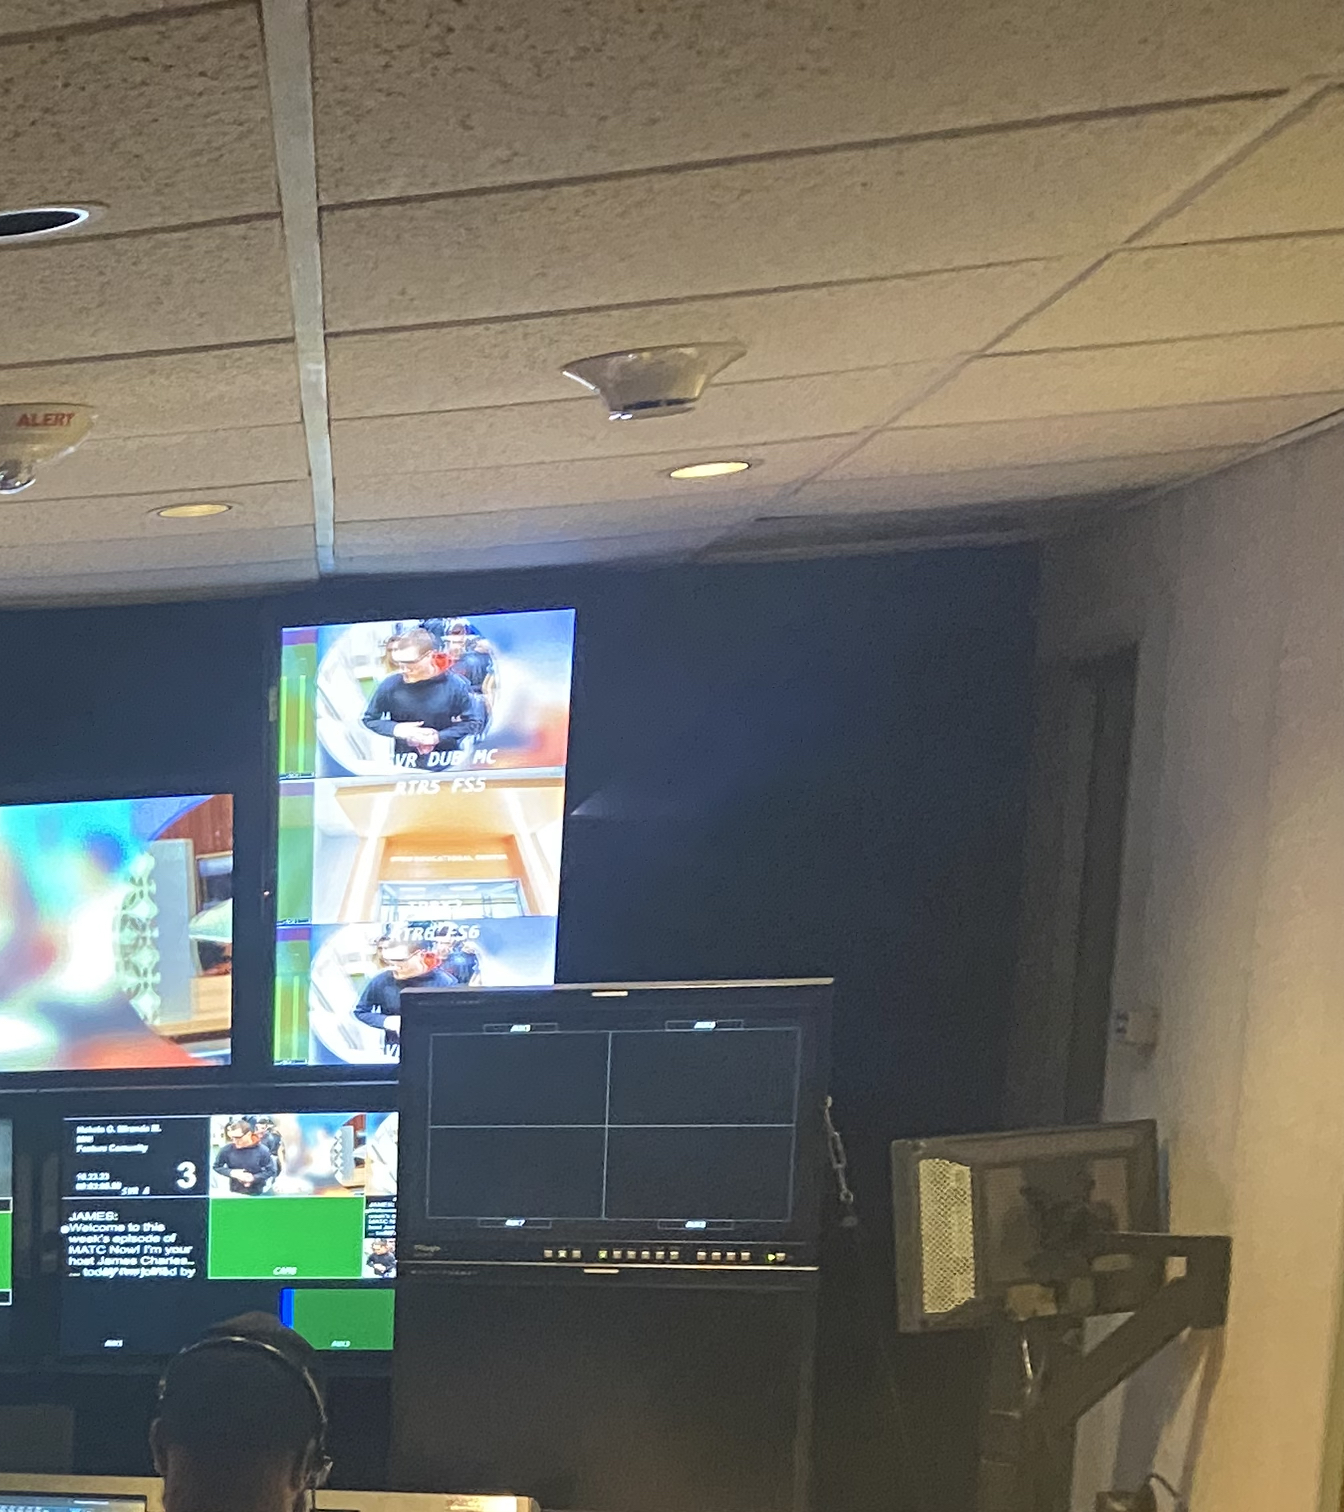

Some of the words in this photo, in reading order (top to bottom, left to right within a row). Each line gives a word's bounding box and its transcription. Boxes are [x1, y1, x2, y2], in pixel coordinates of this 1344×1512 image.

[16, 412, 75, 427] ALERT
[473, 749, 498, 764] MC
[176, 1161, 197, 1190] 3
[68, 1211, 119, 1221] JAMES:
[69, 1223, 125, 1232] Welcome
[127, 1222, 140, 1232] to
[143, 1222, 166, 1232] this
[68, 1245, 106, 1254] MATC
[164, 1246, 193, 1255] your
[68, 1256, 95, 1265] host
[97, 1256, 137, 1265] James
